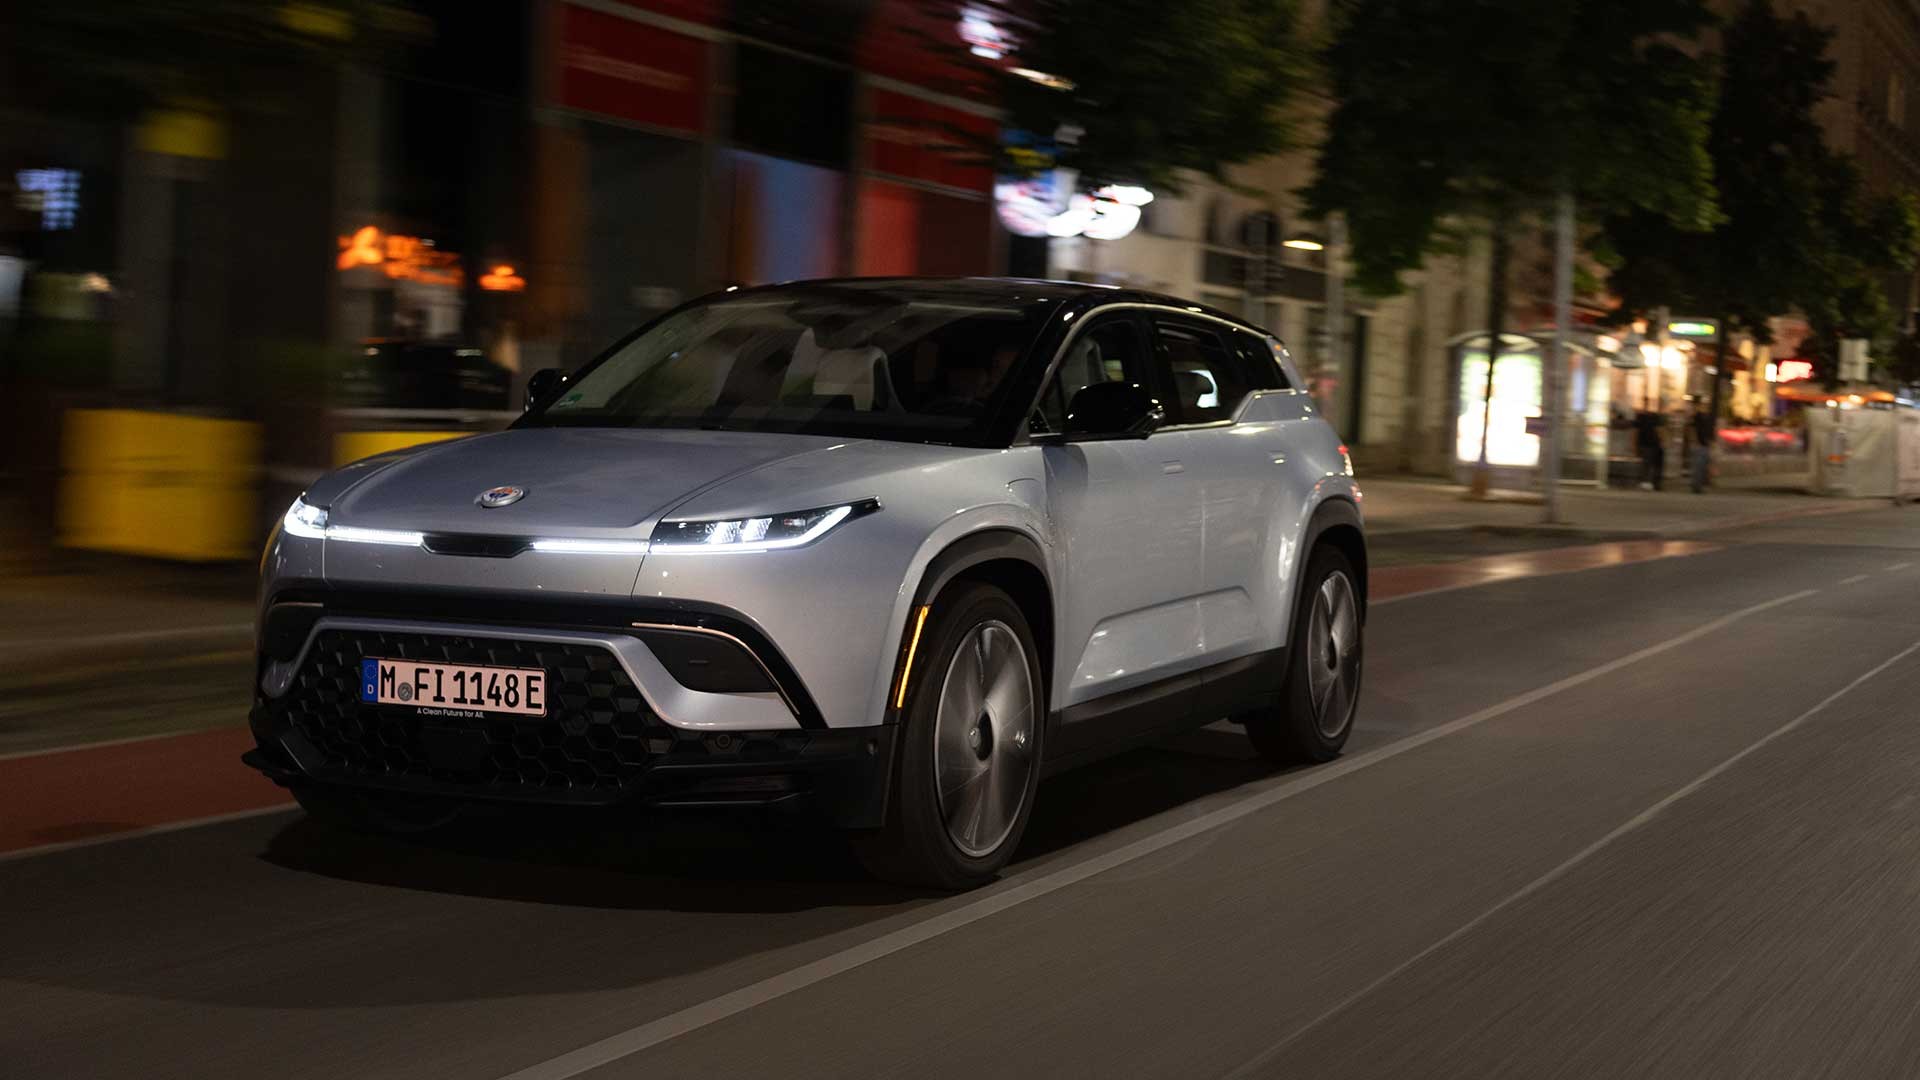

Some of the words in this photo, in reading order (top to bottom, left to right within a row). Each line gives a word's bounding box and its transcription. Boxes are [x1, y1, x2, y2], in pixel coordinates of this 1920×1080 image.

[380, 665, 396, 699] M
[367, 684, 375, 695] D
[416, 707, 422, 715] A
[422, 707, 442, 717] Clean
[443, 708, 464, 718] Future
[464, 710, 474, 718] for
